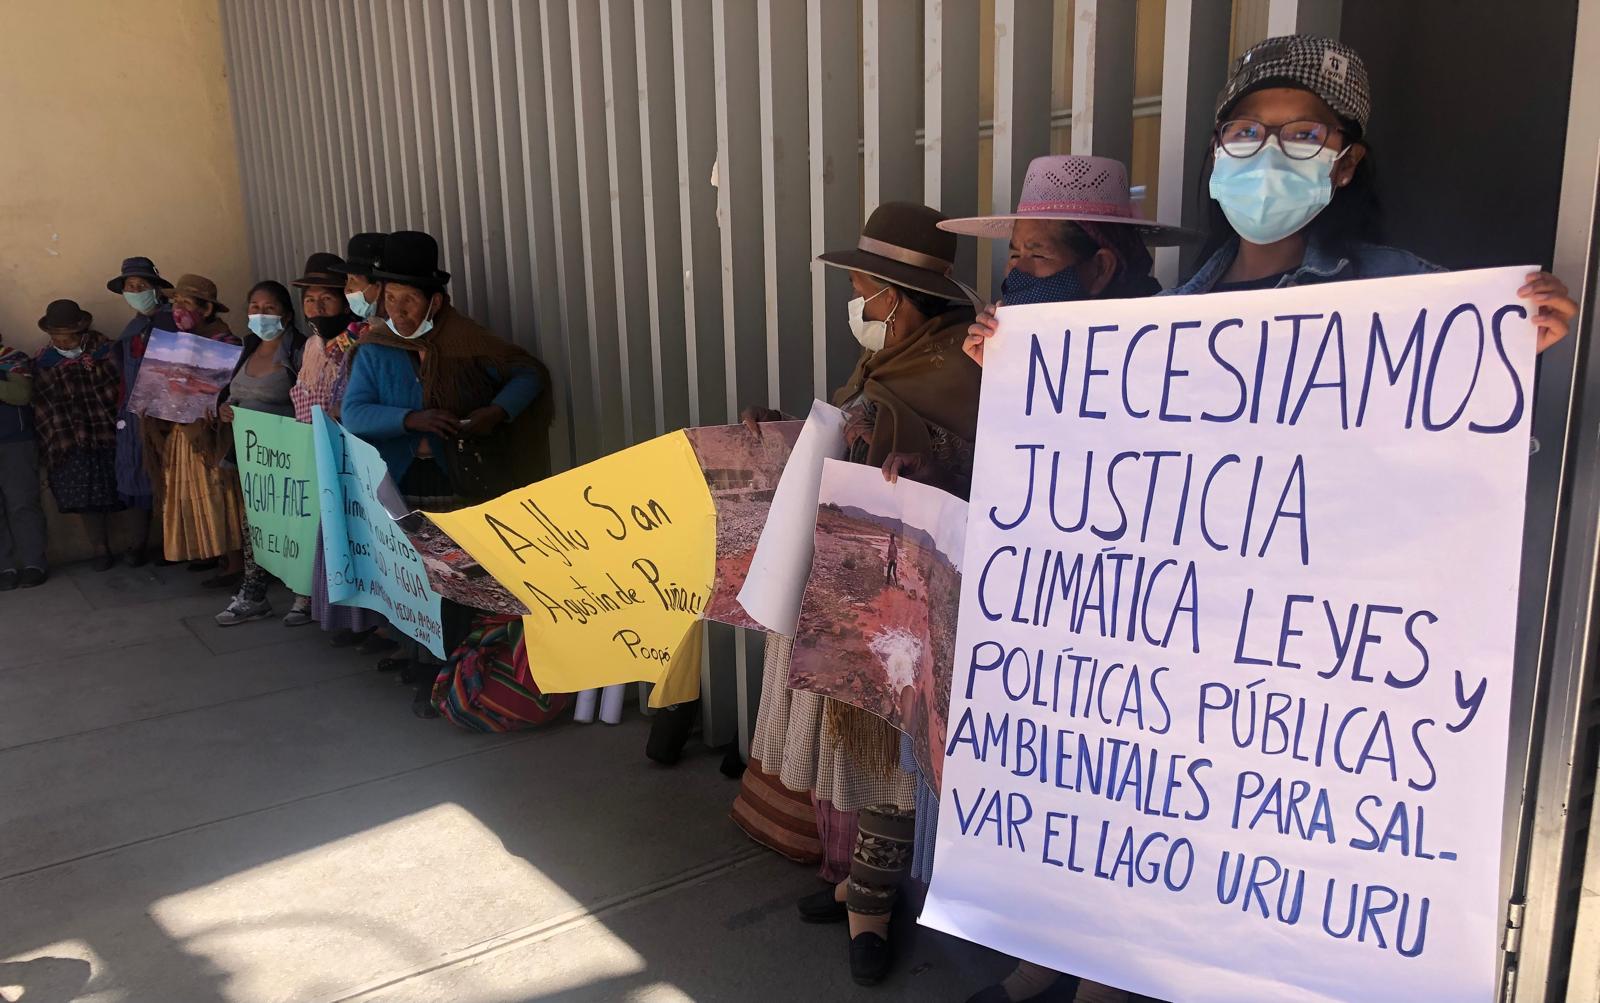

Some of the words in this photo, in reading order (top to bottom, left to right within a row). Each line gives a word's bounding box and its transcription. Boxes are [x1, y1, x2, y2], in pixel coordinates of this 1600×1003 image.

[1024, 302, 1528, 434] NECESITAMOS
[267, 534, 281, 554] EL
[484, 498, 590, 567] Ayllu
[583, 485, 672, 541] San
[988, 443, 1310, 566] JUSTICIA
[394, 562, 429, 602] AGUA
[977, 545, 1200, 653] CLIMÁTICA
[1234, 587, 1439, 690] LEYES
[612, 628, 671, 666] Poopó
[965, 641, 1172, 736] POLÍTICAS
[1199, 678, 1437, 792] PÚBLICAS
[946, 707, 1214, 821] AMBIENTALES
[1231, 770, 1337, 846] PARA
[1349, 794, 1458, 862] SAL-
[951, 787, 1034, 852] VAR
[1042, 811, 1084, 875] EL
[1093, 820, 1195, 892] LAGO
[1217, 850, 1306, 925] URU
[1321, 877, 1431, 959] URU
